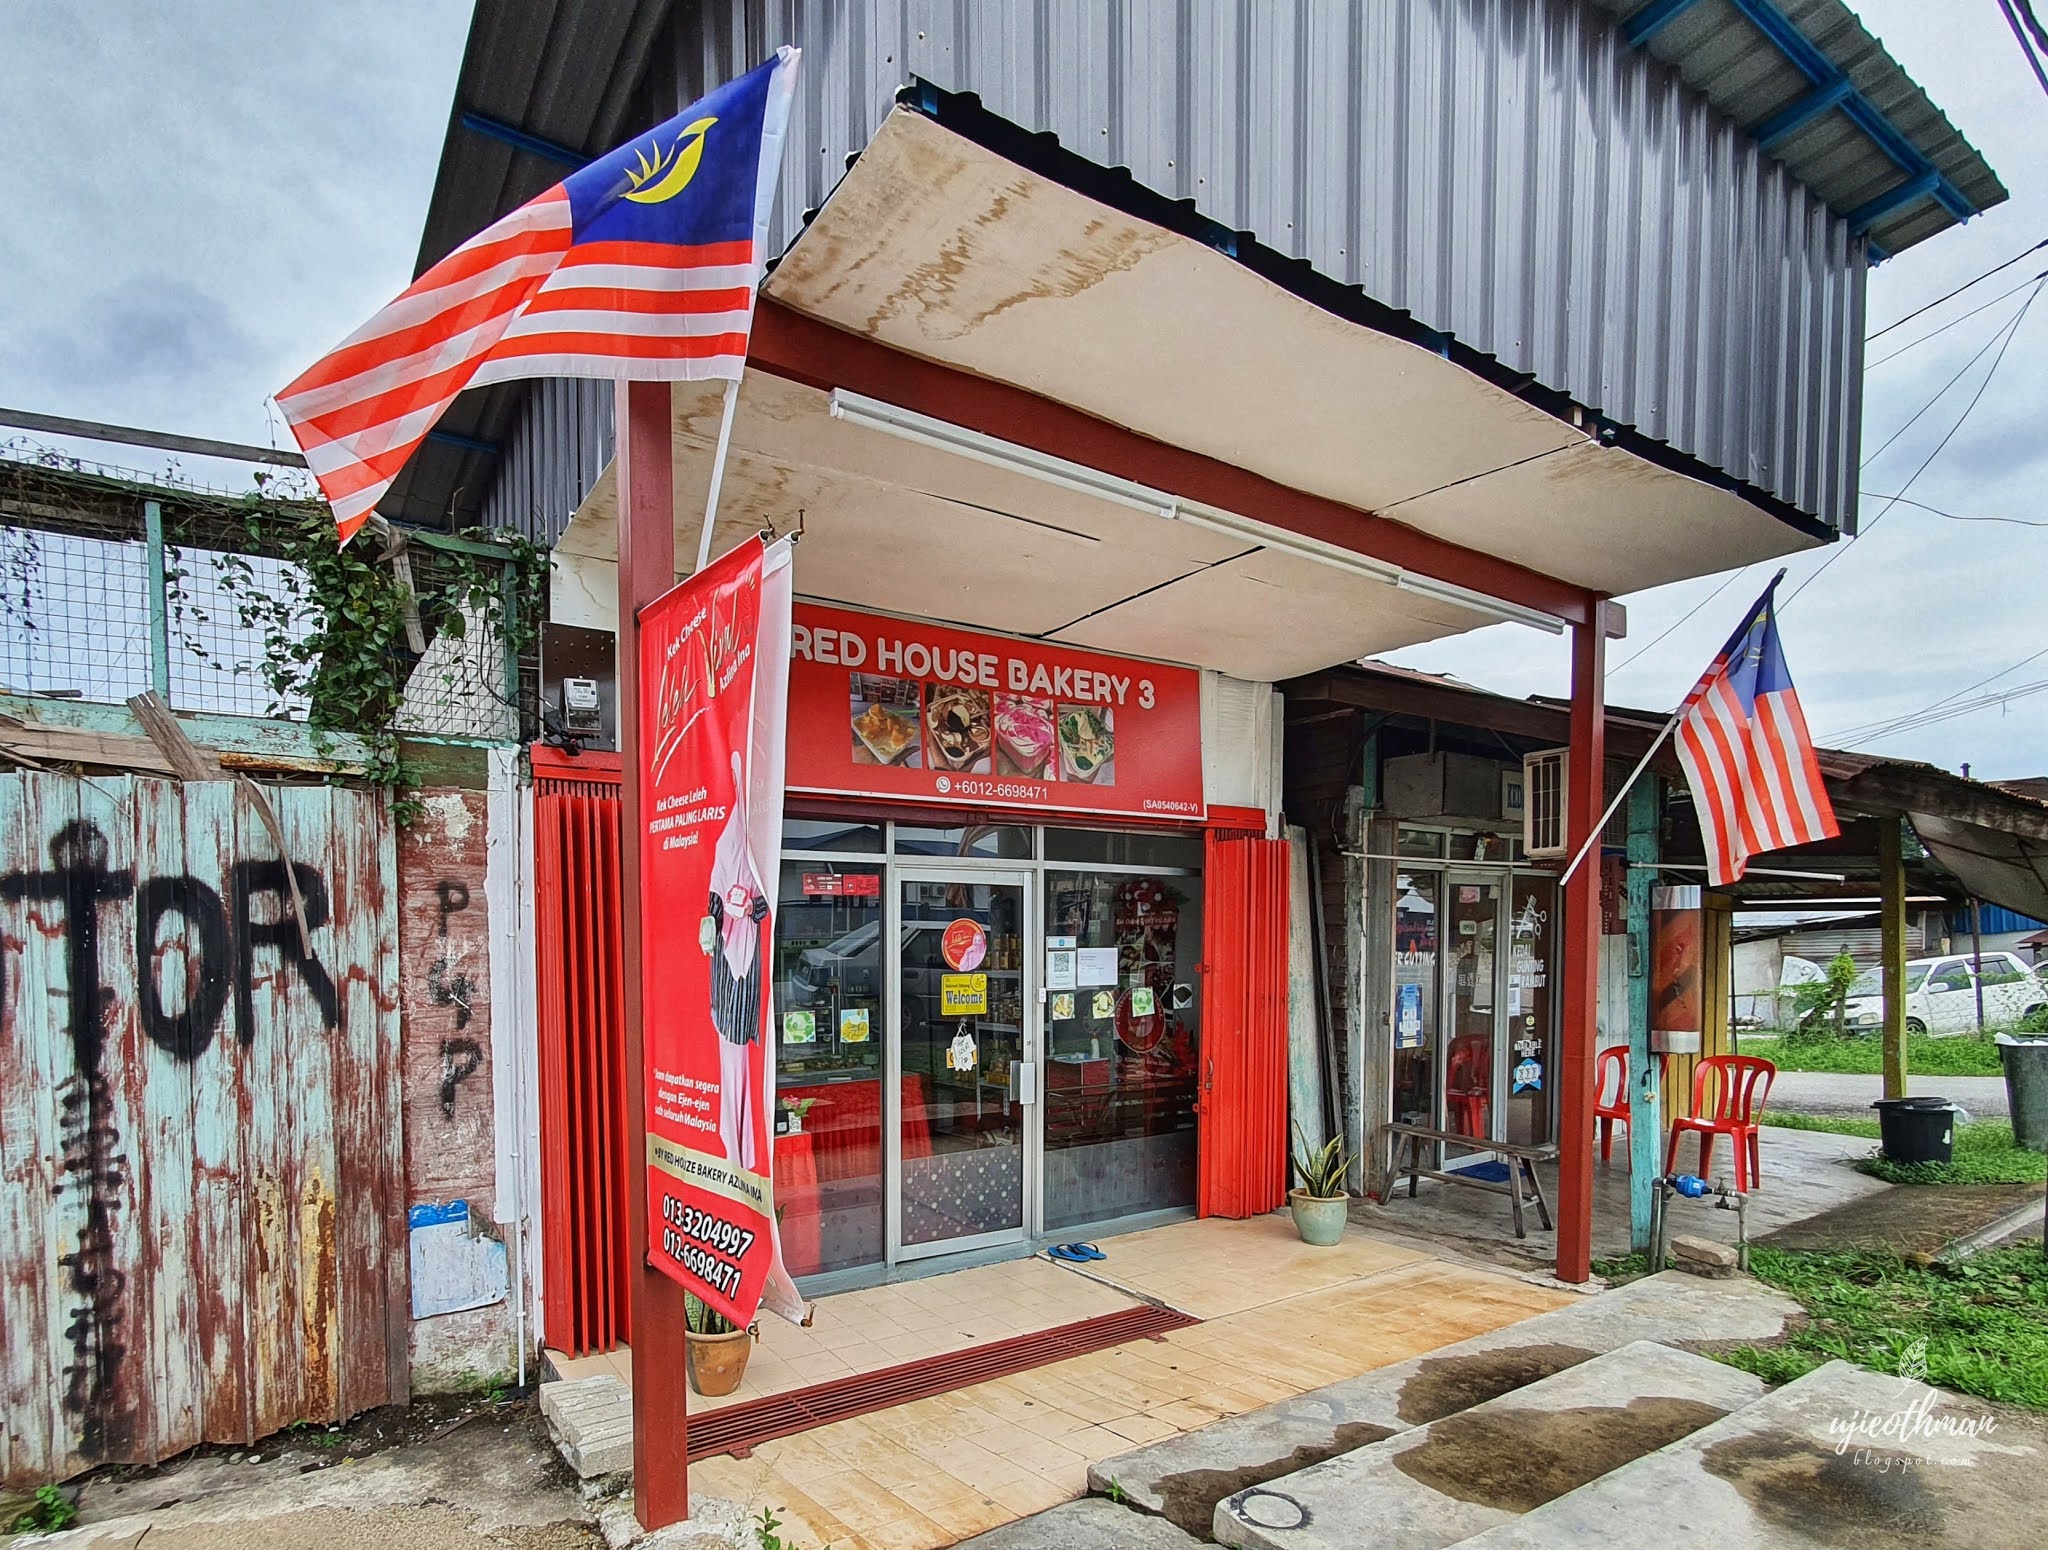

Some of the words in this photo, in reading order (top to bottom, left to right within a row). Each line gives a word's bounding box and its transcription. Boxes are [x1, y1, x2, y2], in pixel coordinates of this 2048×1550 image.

[666, 636, 681, 661] Kek
[681, 607, 707, 643] Cheese
[737, 643, 751, 667] Ina
[791, 624, 867, 667] RED
[878, 637, 999, 687] HOUSE
[1008, 658, 1130, 705] BAKERY
[1138, 680, 1156, 709] 3
[656, 797, 667, 812] Kek
[667, 794, 688, 809] Cheese
[689, 786, 707, 803] Leleh
[953, 781, 1048, 799] +6012-6698471
[1143, 799, 1198, 814] (SA0540642-V)
[649, 816, 674, 834] PERTAMA
[675, 809, 697, 827] PALING
[698, 806, 726, 822] LARIS
[663, 836, 669, 850] di
[669, 830, 699, 850] Malaysia!
[0, 820, 338, 1072] TOR
[1512, 944, 1532, 958] KEDAI
[1404, 952, 1436, 966] CUTTING
[1516, 959, 1544, 973] GUNTING
[1520, 974, 1546, 988] RAMBUT
[945, 990, 983, 1004] Welcome
[665, 1071, 693, 1088] dapatkan
[695, 1080, 720, 1094] segera
[658, 1086, 677, 1103] dengan
[678, 1093, 710, 1111] Ejen-ejen
[664, 1108, 683, 1123] seluruh
[685, 1113, 717, 1132] Malaysia
[664, 1152, 674, 1165] RED
[697, 1163, 728, 1185] BAKERY
[750, 1185, 763, 1203] INA
[662, 1194, 754, 1260] 013-3204997
[662, 1227, 742, 1299] 012-6698471
